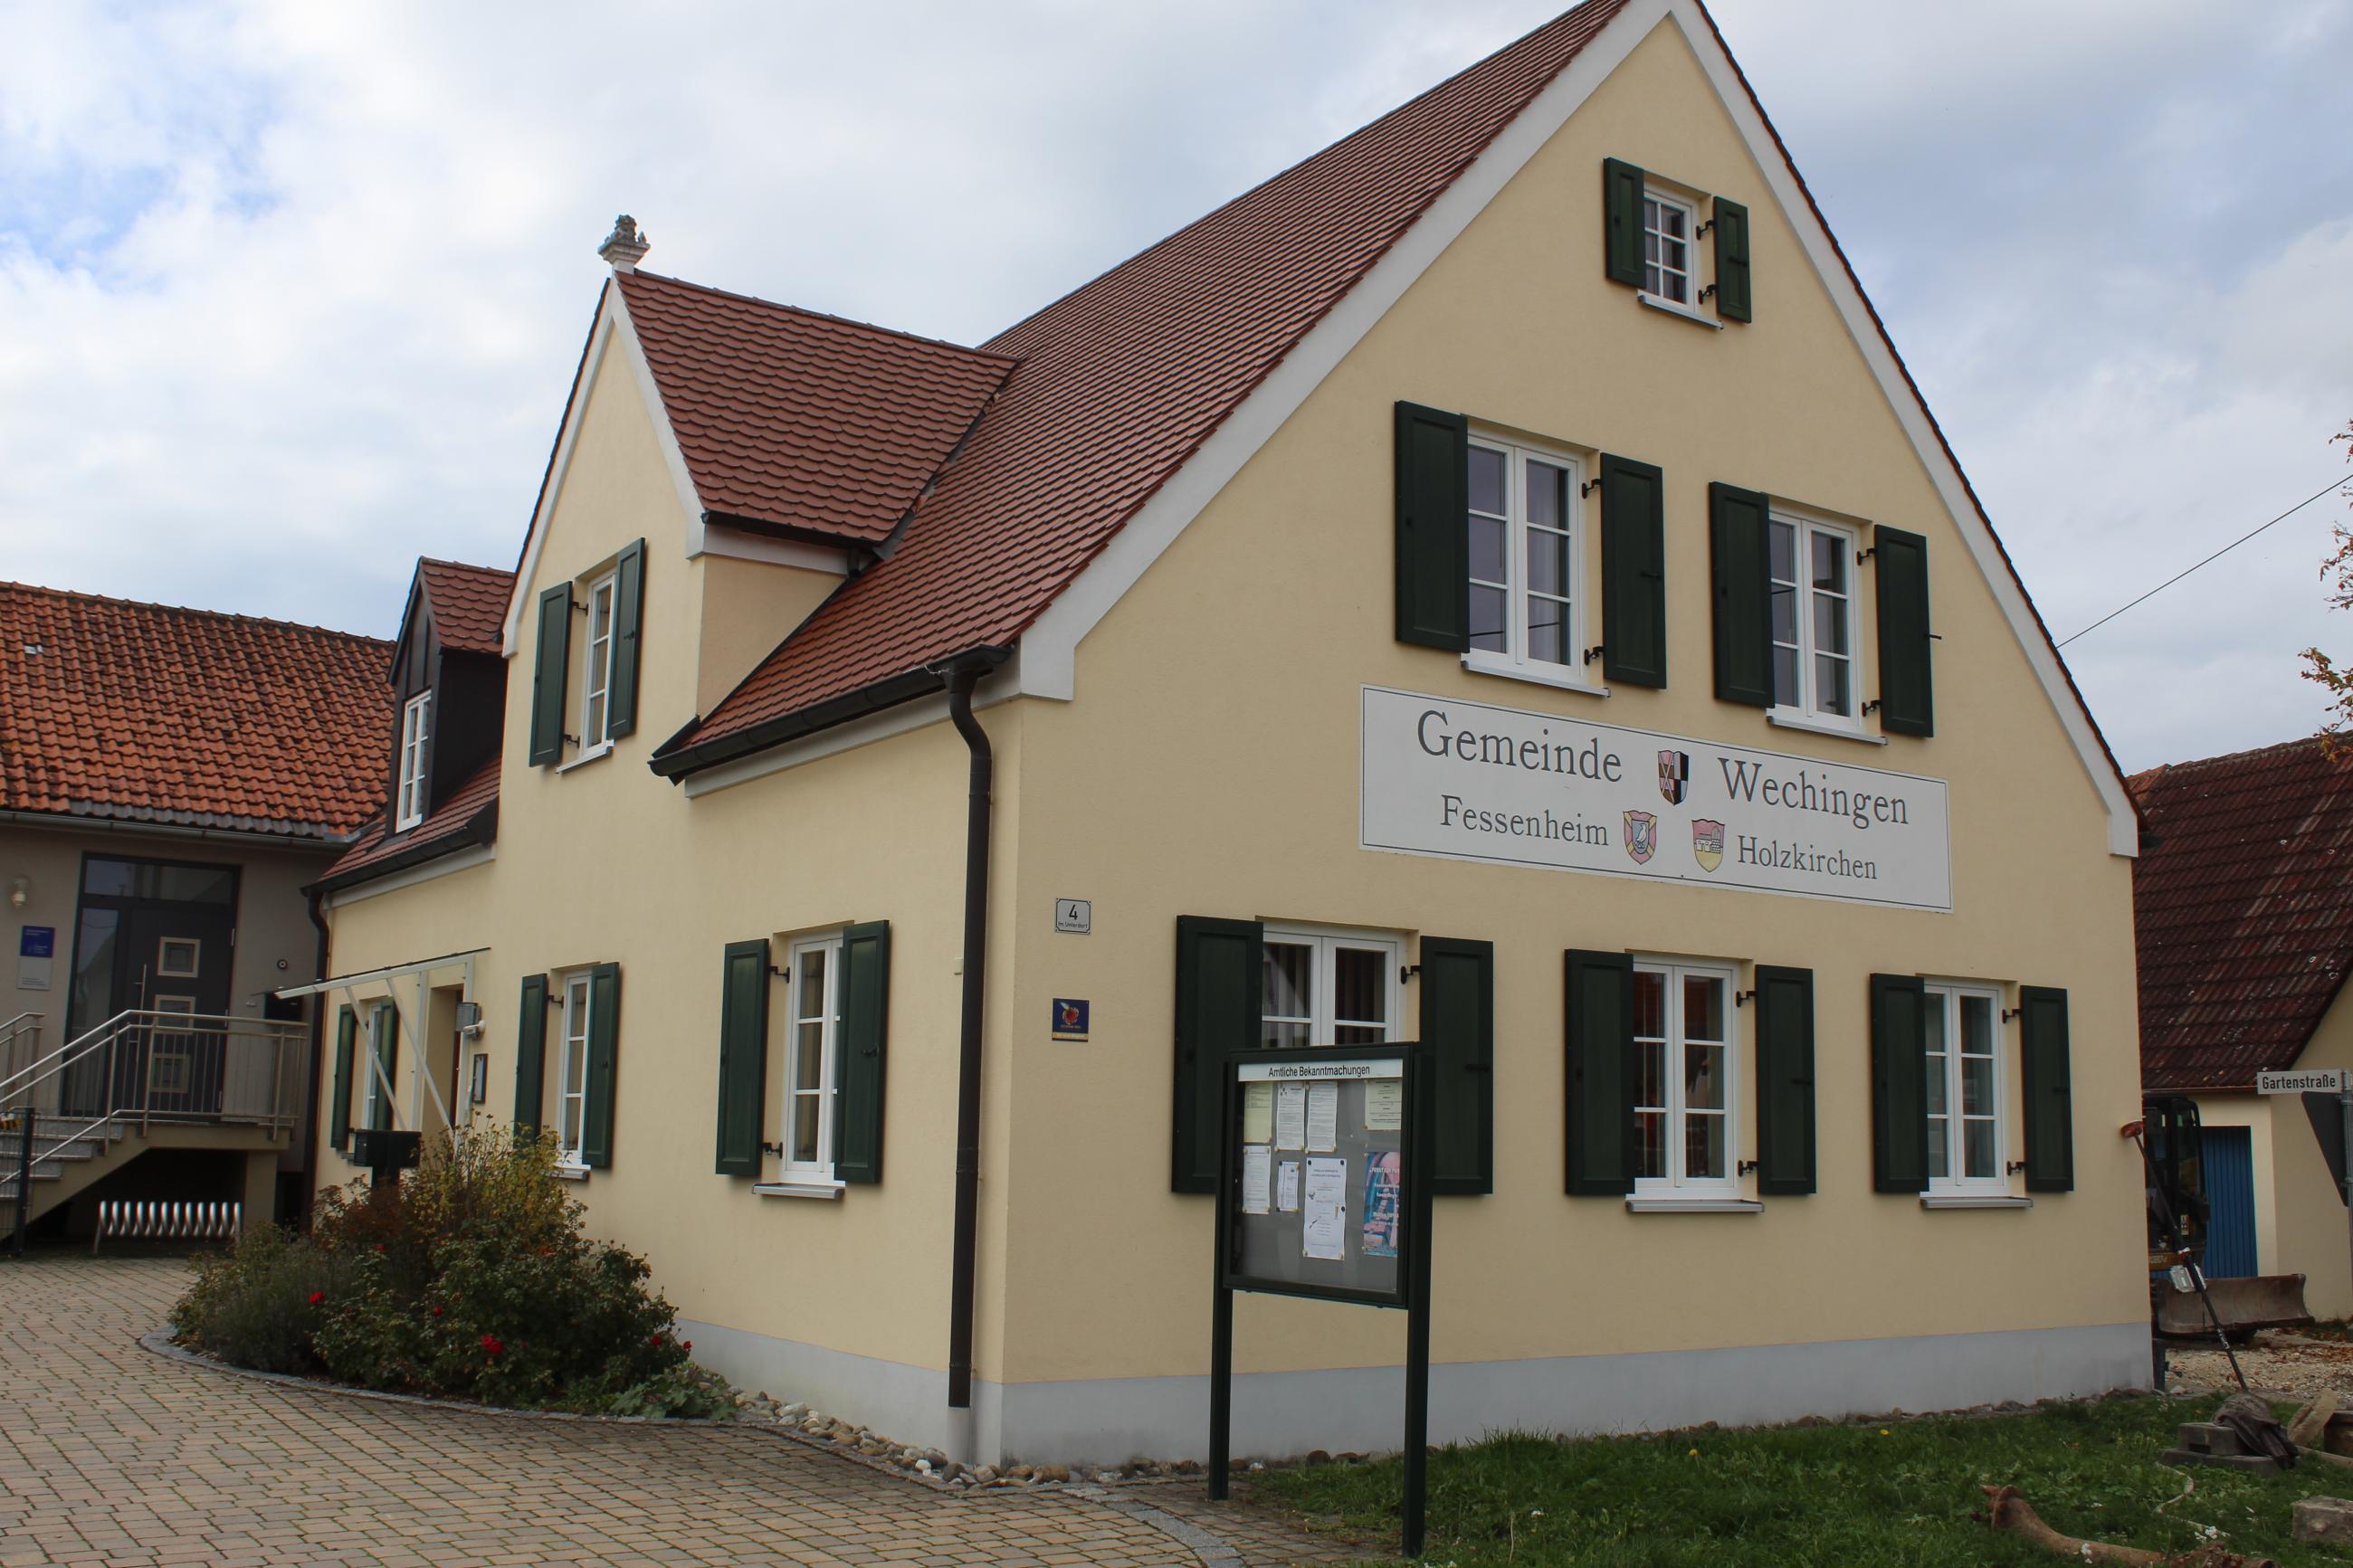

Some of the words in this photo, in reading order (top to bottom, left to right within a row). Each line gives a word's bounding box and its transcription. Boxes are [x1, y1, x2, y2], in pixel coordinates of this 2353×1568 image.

[1417, 709, 1623, 783] Gemeinde
[1717, 756, 1910, 830] Wechingen
[1440, 794, 1609, 846] Fessenheim
[1737, 834, 1878, 879] Holzkirchen
[1069, 904, 1078, 920] 4
[1268, 1066, 1298, 1078] Amtliche
[1299, 1064, 1370, 1078] Bekanntmachungen
[2262, 1073, 2336, 1090] Gartenstraße
